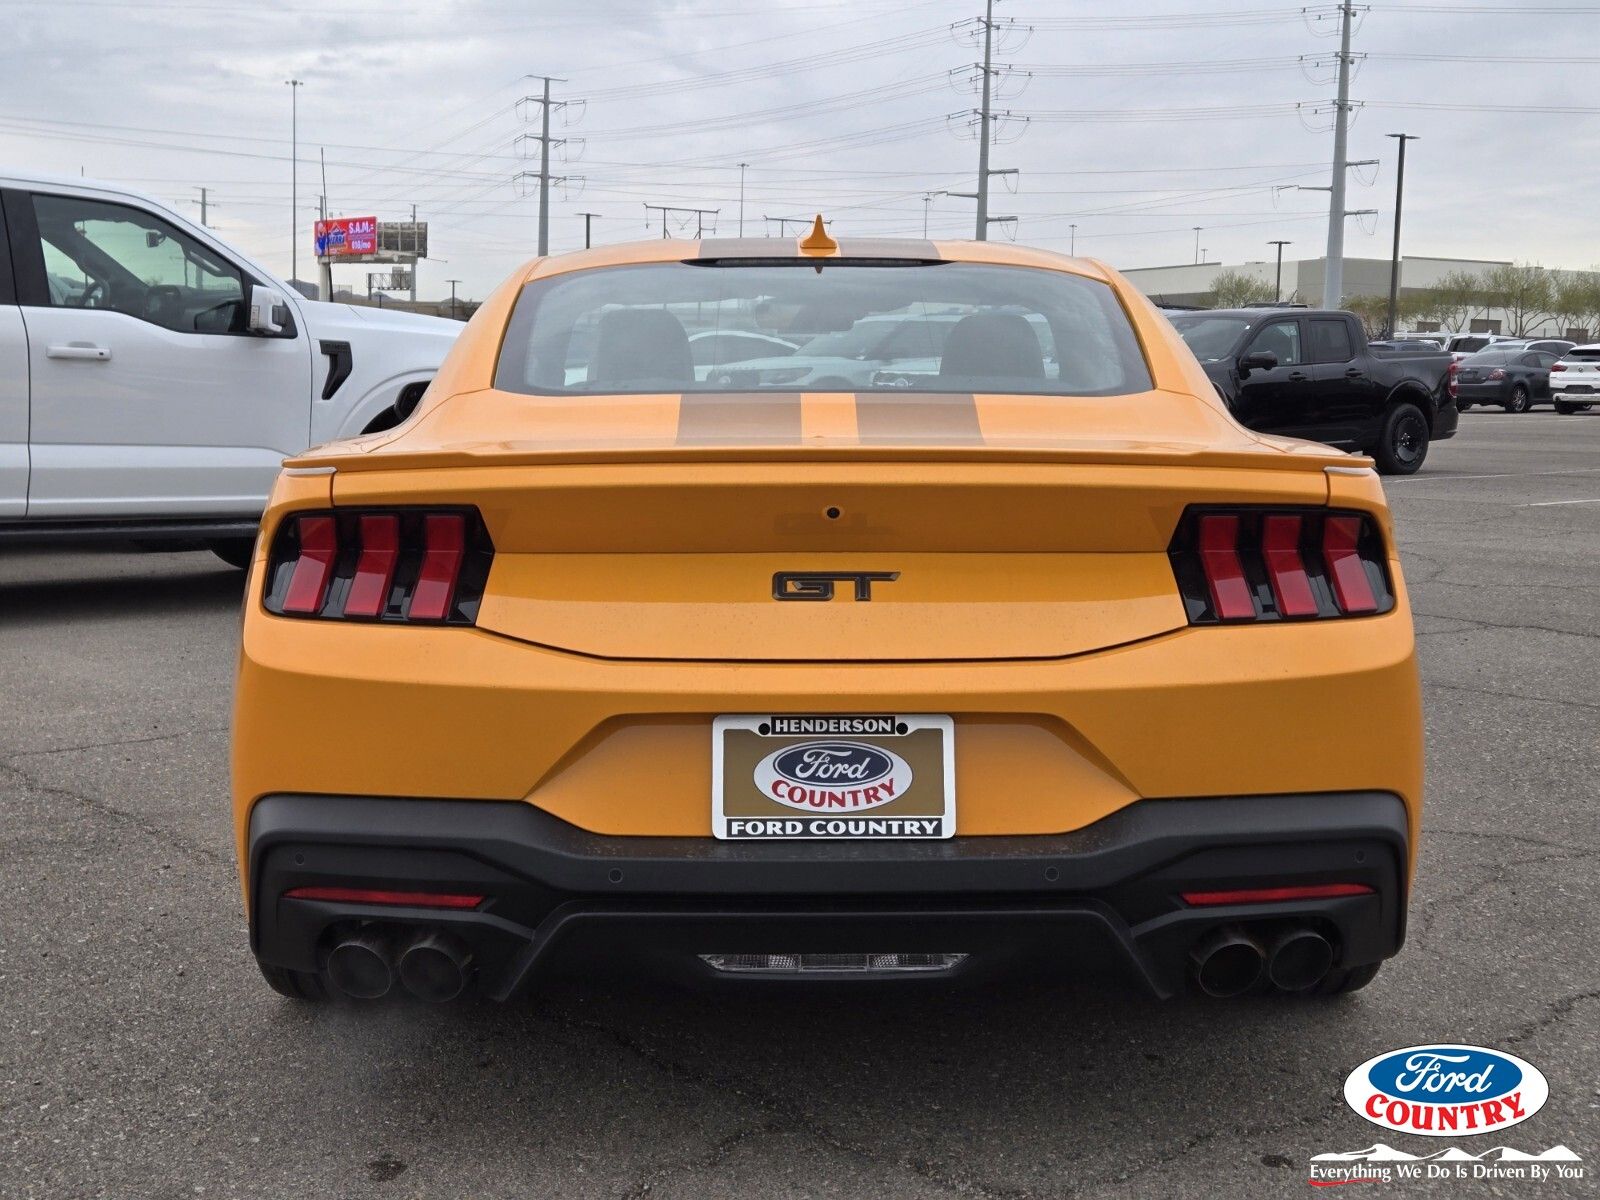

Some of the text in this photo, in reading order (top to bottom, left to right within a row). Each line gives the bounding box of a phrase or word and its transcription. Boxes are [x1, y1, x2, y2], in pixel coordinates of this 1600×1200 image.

[772, 571, 901, 601] GT
[776, 720, 891, 732] HENDERSON
[795, 749, 871, 779] Ford
[771, 778, 895, 808] COUNTRY
[732, 821, 938, 835] FORD COUNTRY
